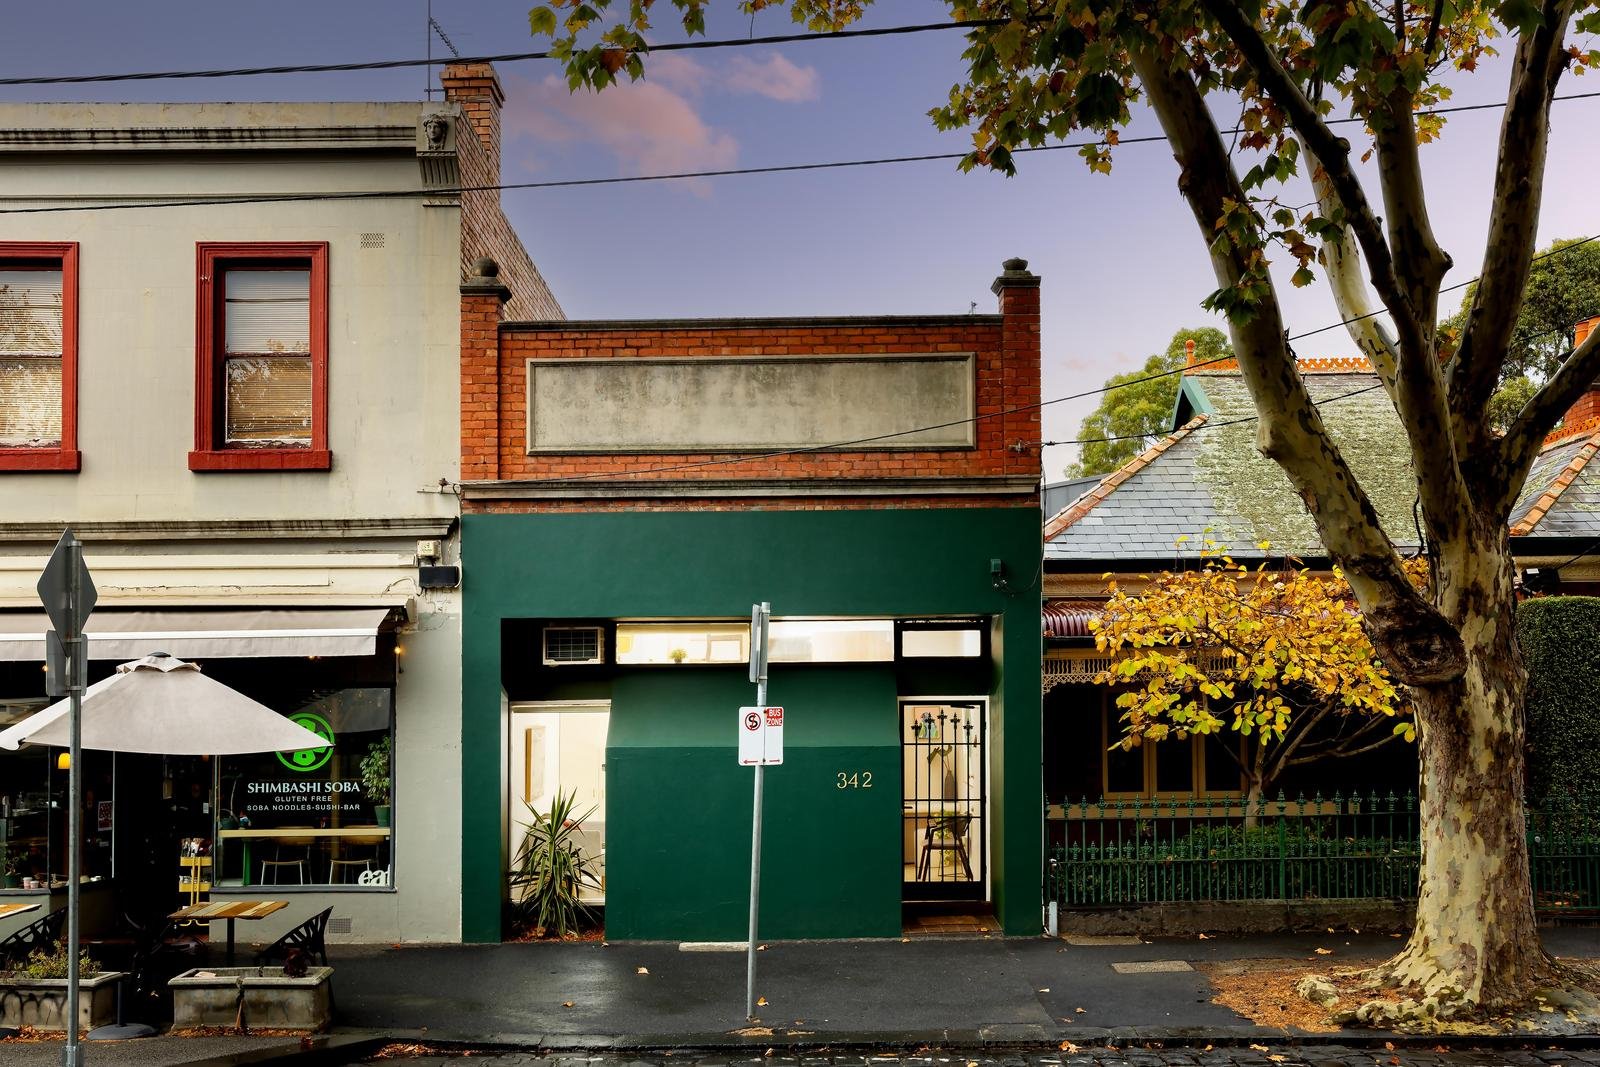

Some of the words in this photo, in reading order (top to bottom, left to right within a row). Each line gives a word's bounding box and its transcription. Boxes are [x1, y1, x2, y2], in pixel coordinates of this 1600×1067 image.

[769, 709, 781, 717] BUS
[767, 718, 783, 726] ZONE
[837, 772, 872, 789] 342
[247, 782, 321, 793] SHIMBASHI
[324, 782, 361, 793] SOBA
